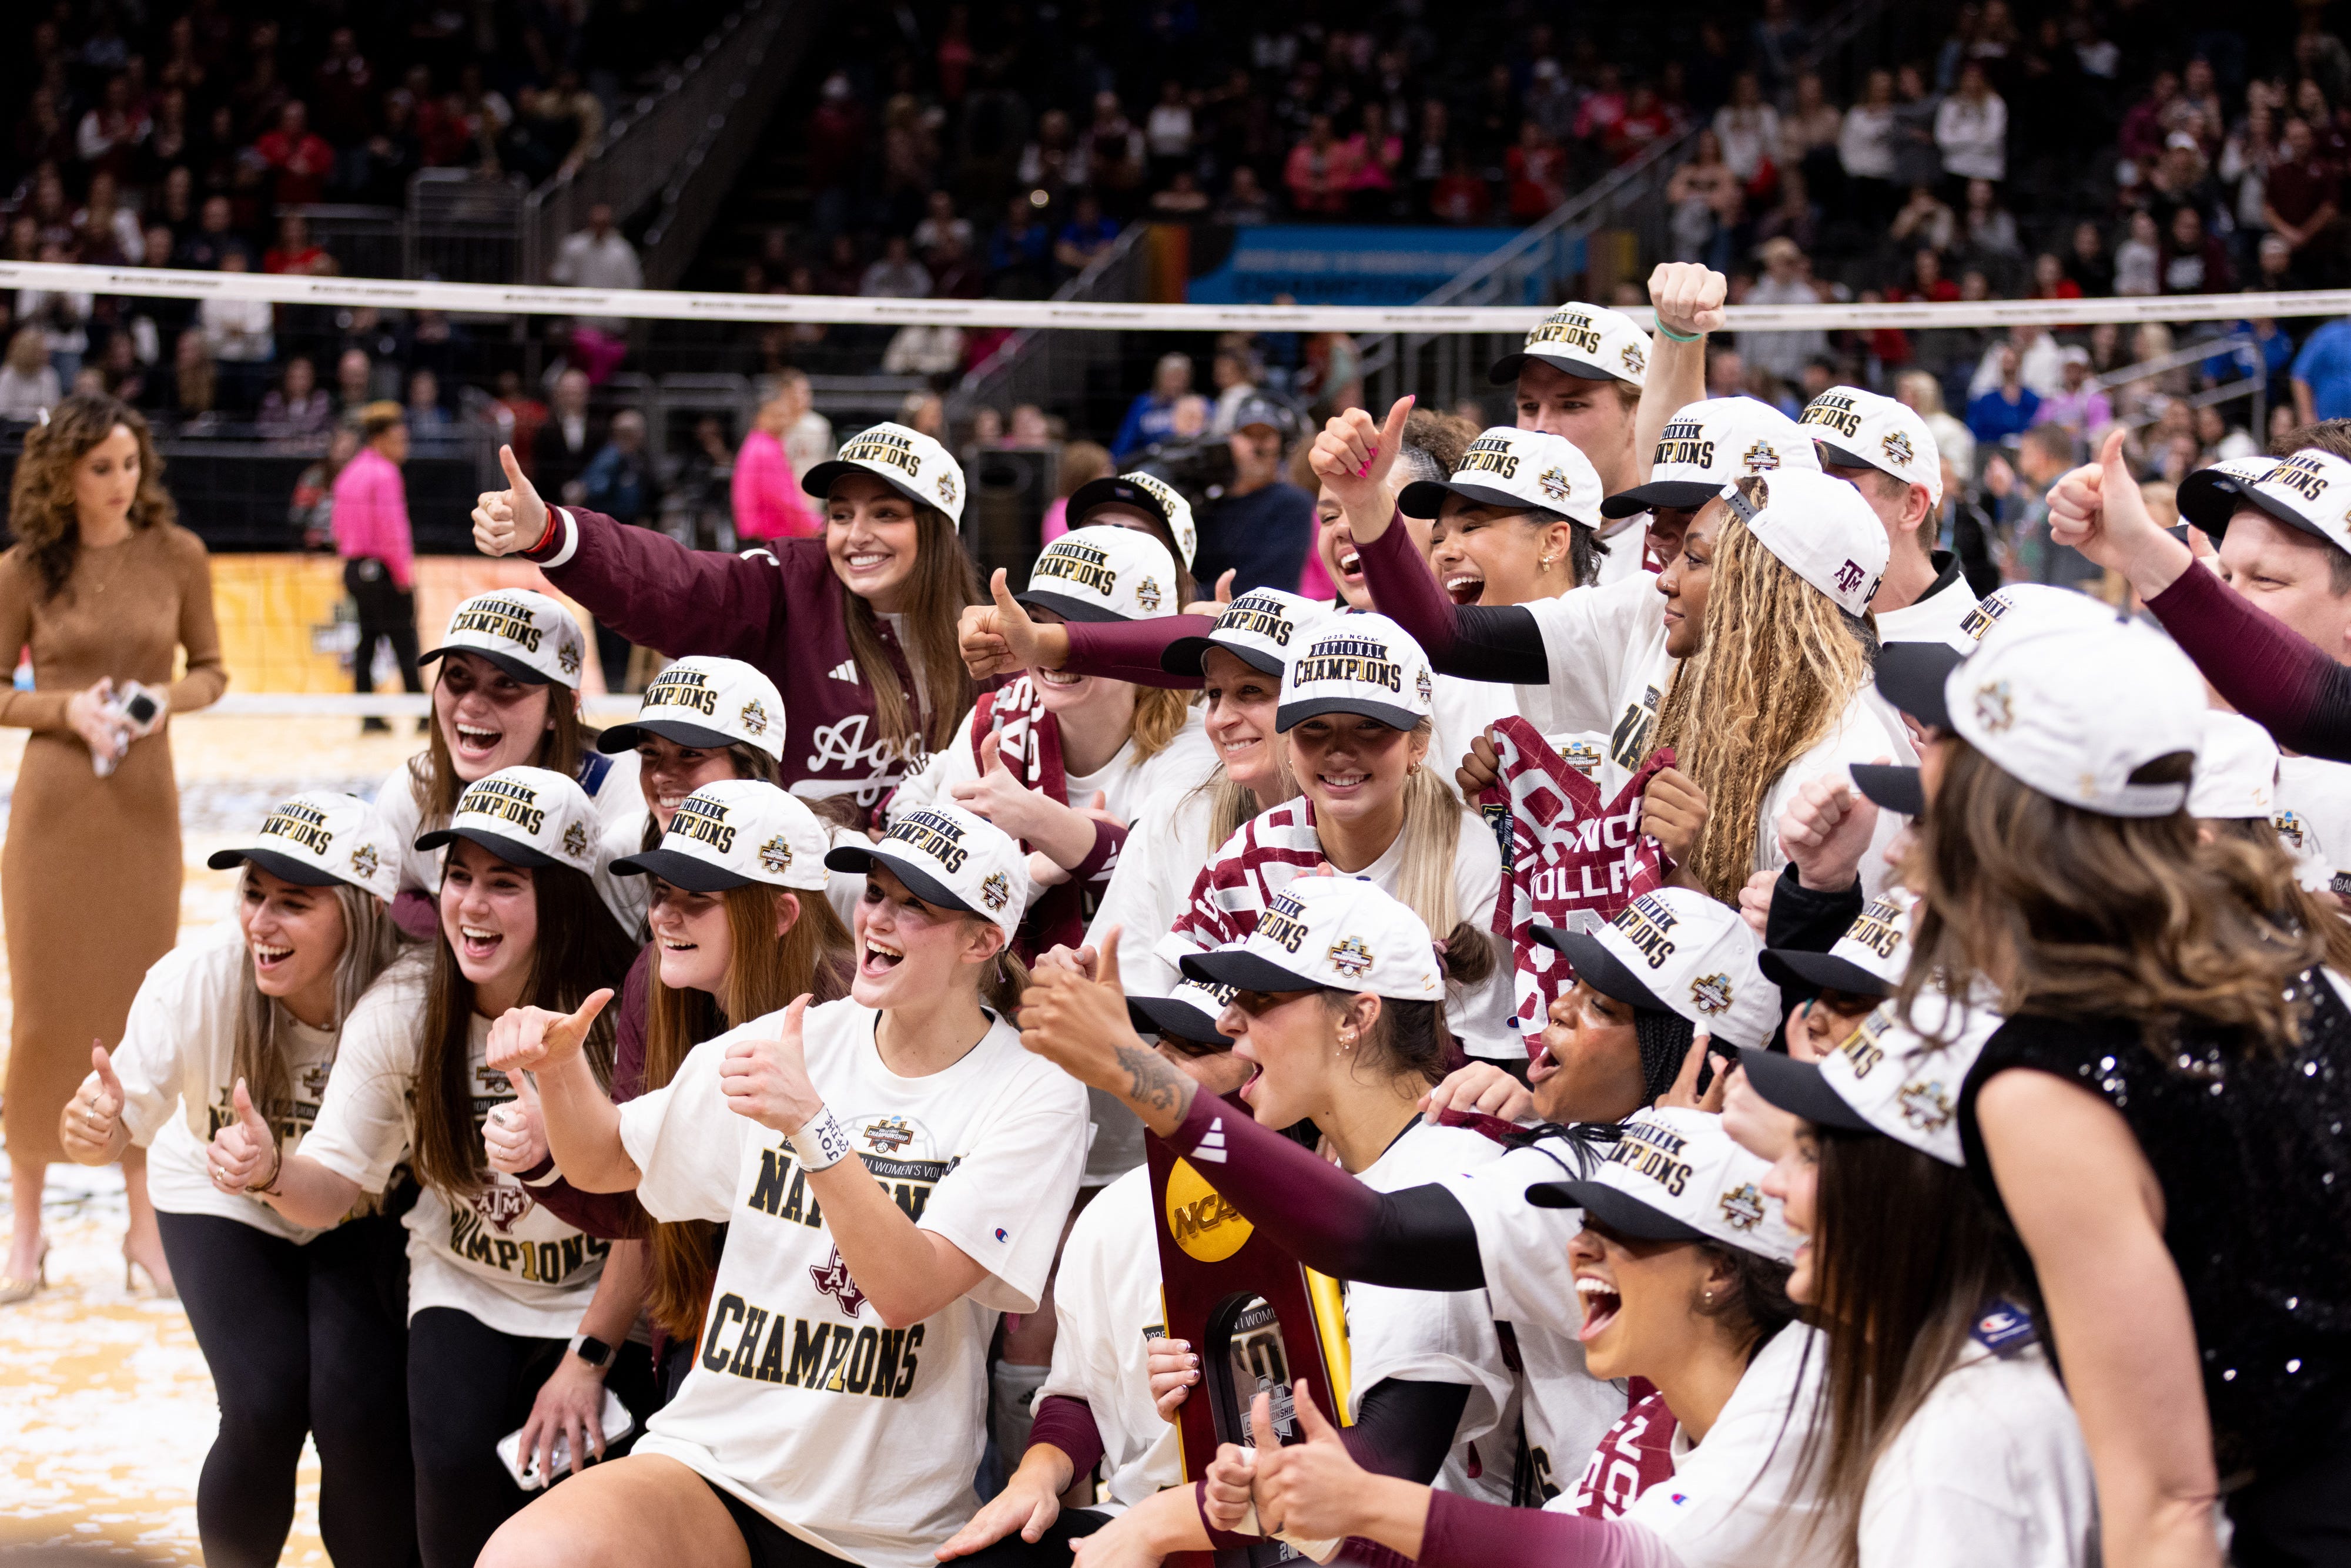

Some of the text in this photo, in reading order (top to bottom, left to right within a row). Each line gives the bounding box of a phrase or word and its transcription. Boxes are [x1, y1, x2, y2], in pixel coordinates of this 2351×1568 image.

[1313, 642, 1381, 658] NATIONAL
[867, 1130, 909, 1142] CHAMPIONSHIP
[815, 1127, 839, 1161] JOY
[836, 1138, 846, 1152] OF
[875, 1161, 922, 1176] WOMEN'S
